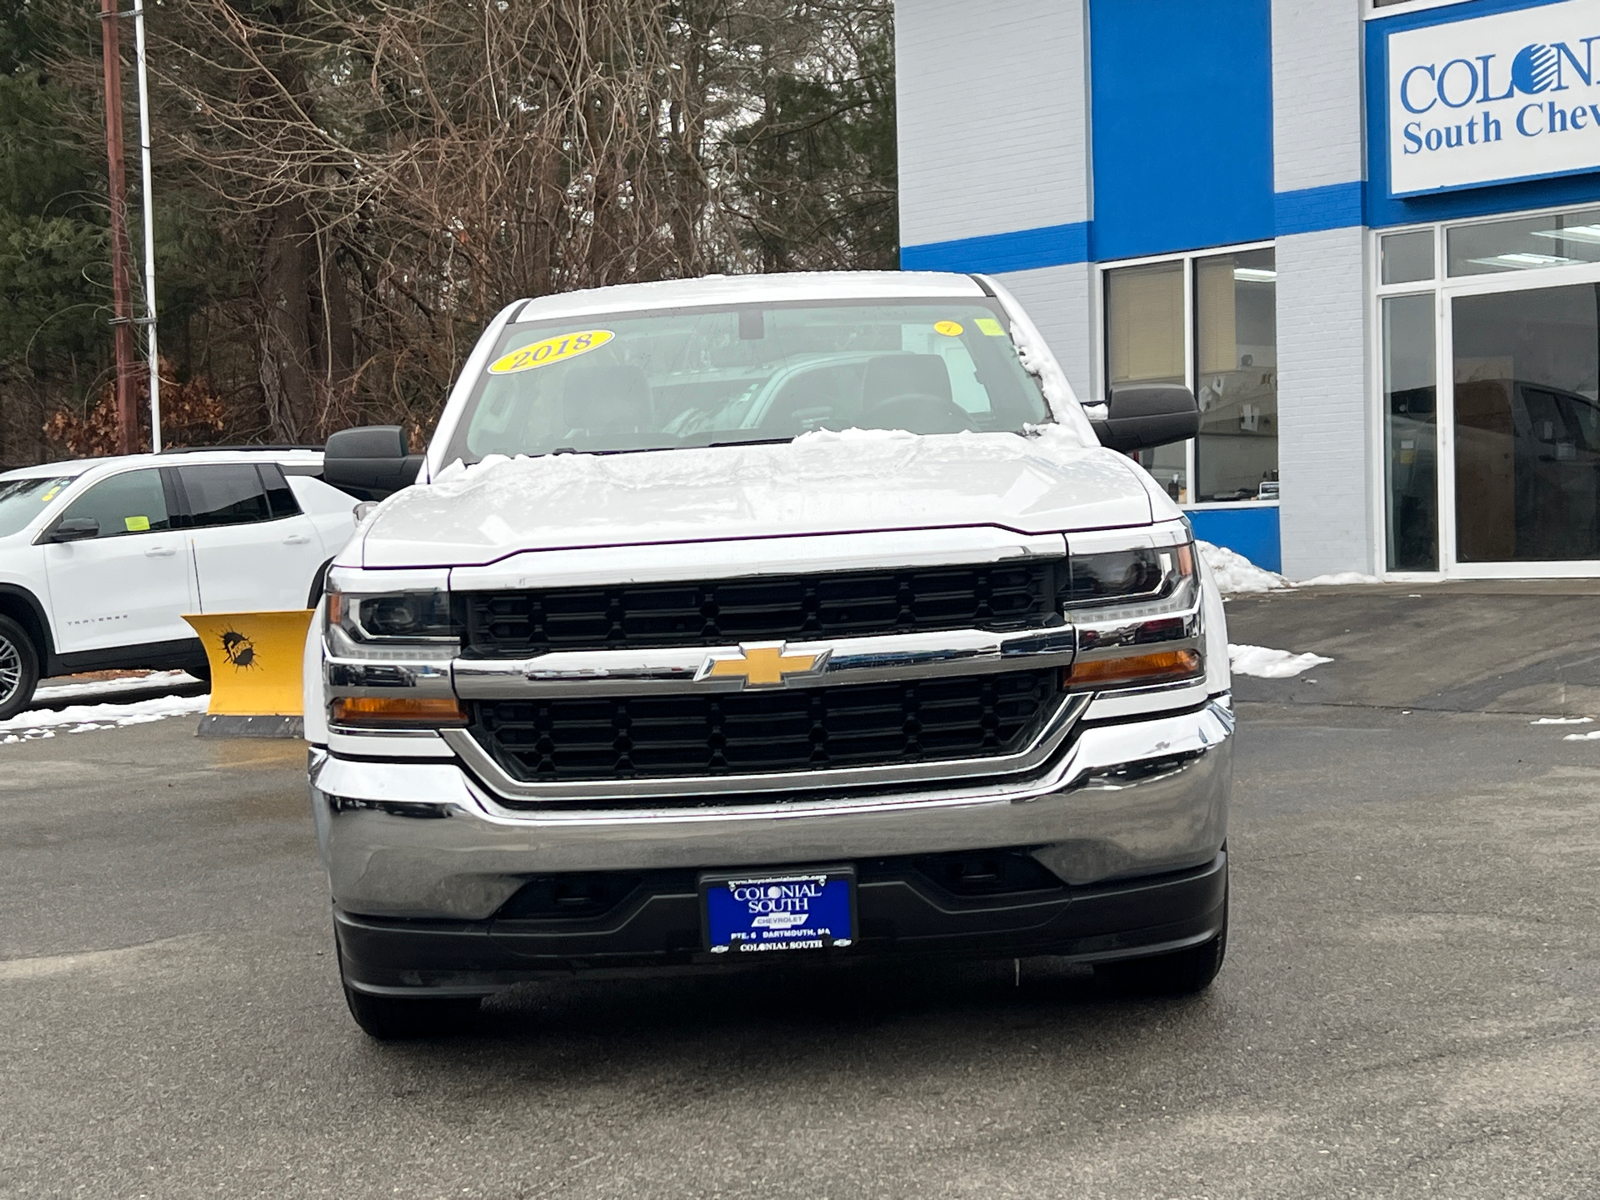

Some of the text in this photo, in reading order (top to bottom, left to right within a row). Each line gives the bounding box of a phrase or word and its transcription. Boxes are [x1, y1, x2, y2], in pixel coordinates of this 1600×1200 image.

[1401, 36, 1600, 114] COLON
[1404, 111, 1502, 155] South
[510, 334, 592, 369] 2018
[734, 884, 822, 901] COLONIAL
[748, 898, 808, 913] SOUTH
[757, 916, 802, 925] CHEVROLET
[740, 940, 823, 952] COLONIAL SOUTH
